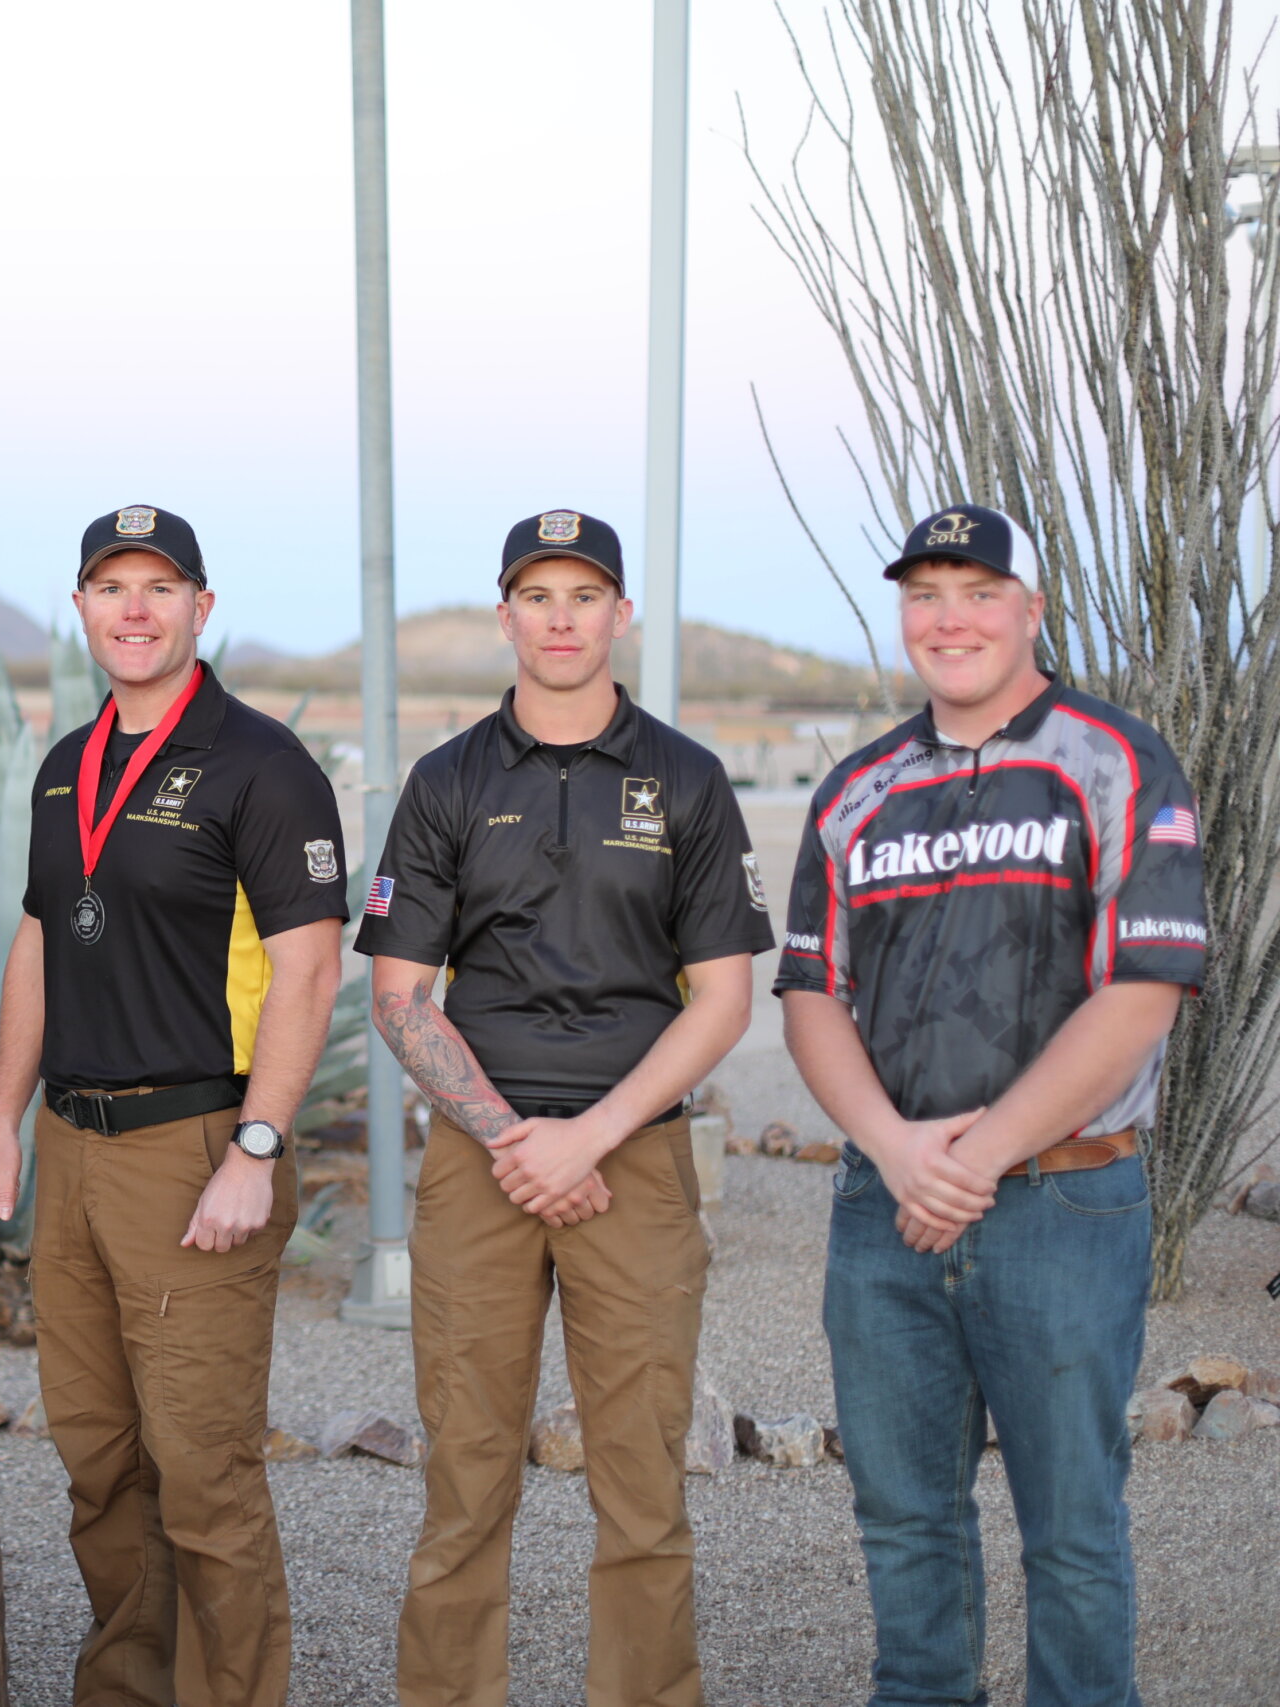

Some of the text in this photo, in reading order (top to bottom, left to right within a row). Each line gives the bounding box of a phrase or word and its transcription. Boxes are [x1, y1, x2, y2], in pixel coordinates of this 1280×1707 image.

[926, 533, 970, 545] COLE
[160, 810, 181, 819] ARMY
[127, 813, 200, 831] MARKSMANSHIP UNIT
[488, 815, 522, 826] DAVEY
[640, 836, 660, 844] ARMY
[849, 816, 1069, 886] Lakewood
